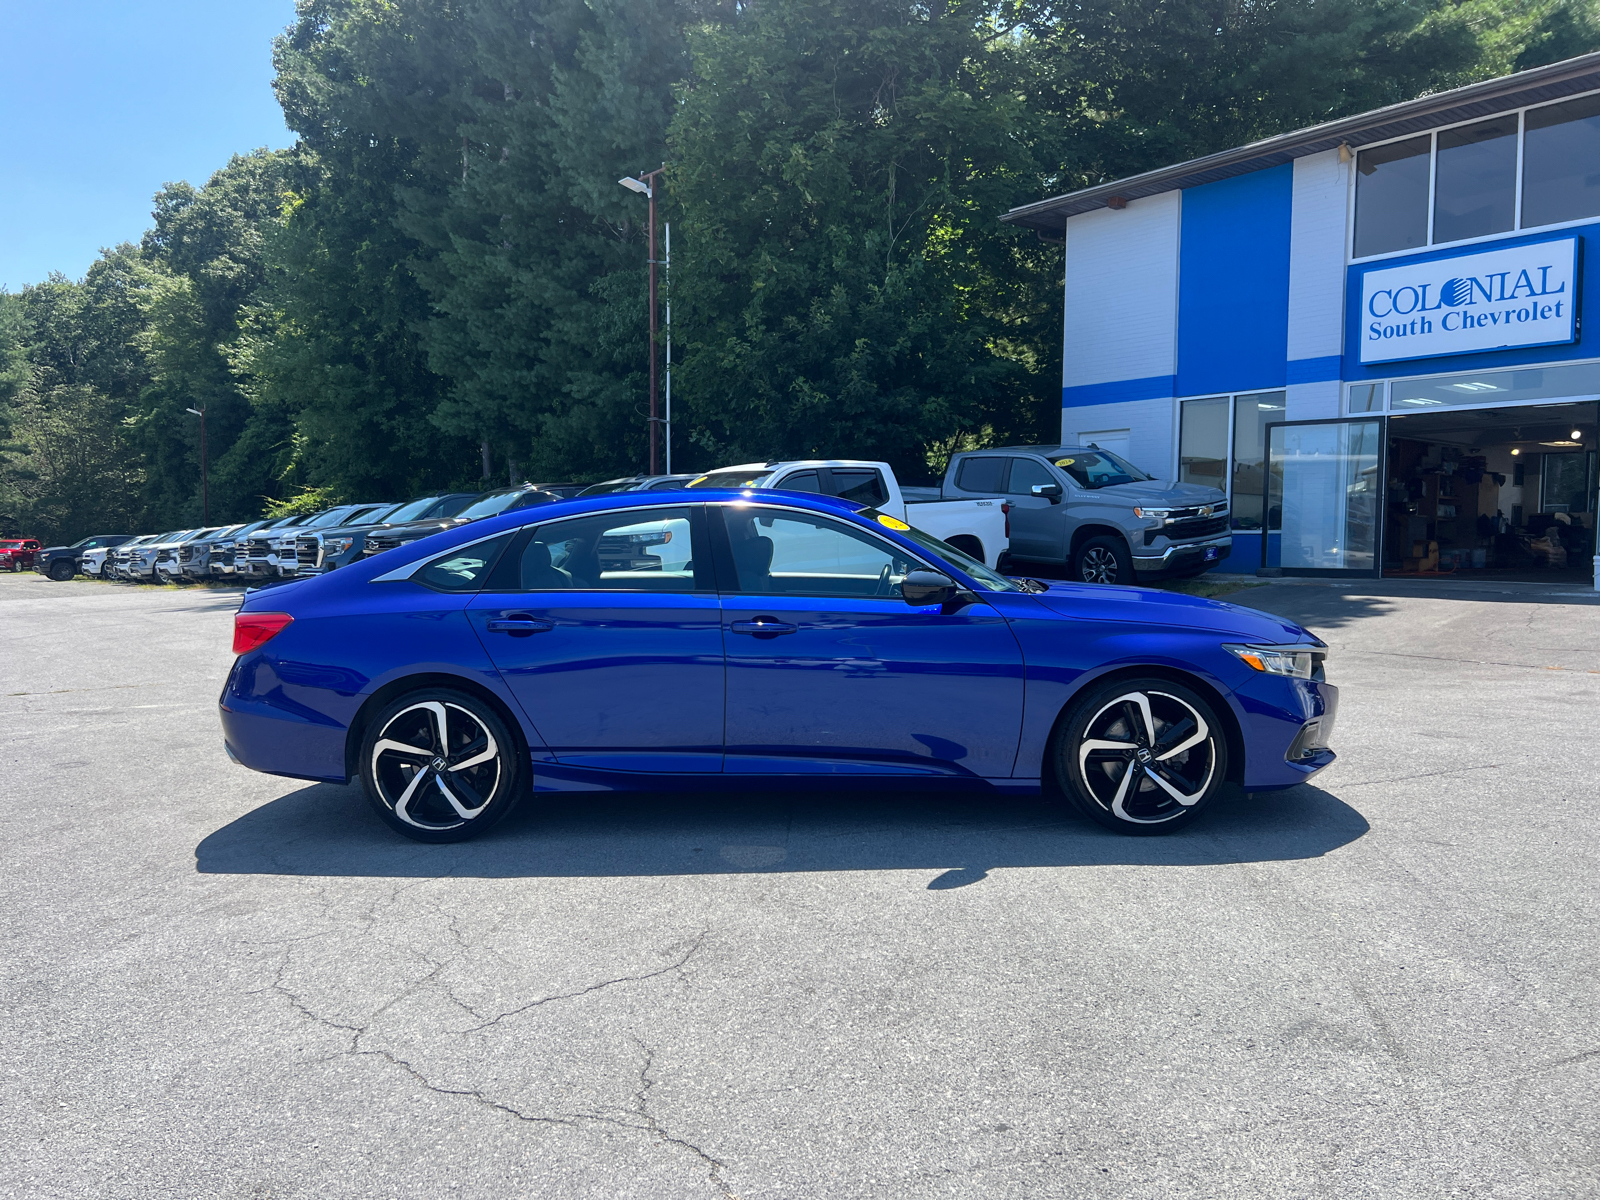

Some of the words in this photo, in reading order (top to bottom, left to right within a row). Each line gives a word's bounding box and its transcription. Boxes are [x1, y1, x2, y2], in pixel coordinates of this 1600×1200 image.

[1368, 265, 1565, 318] COLONIAL
[1368, 315, 1433, 341] South
[1441, 300, 1564, 332] Chevrolet
